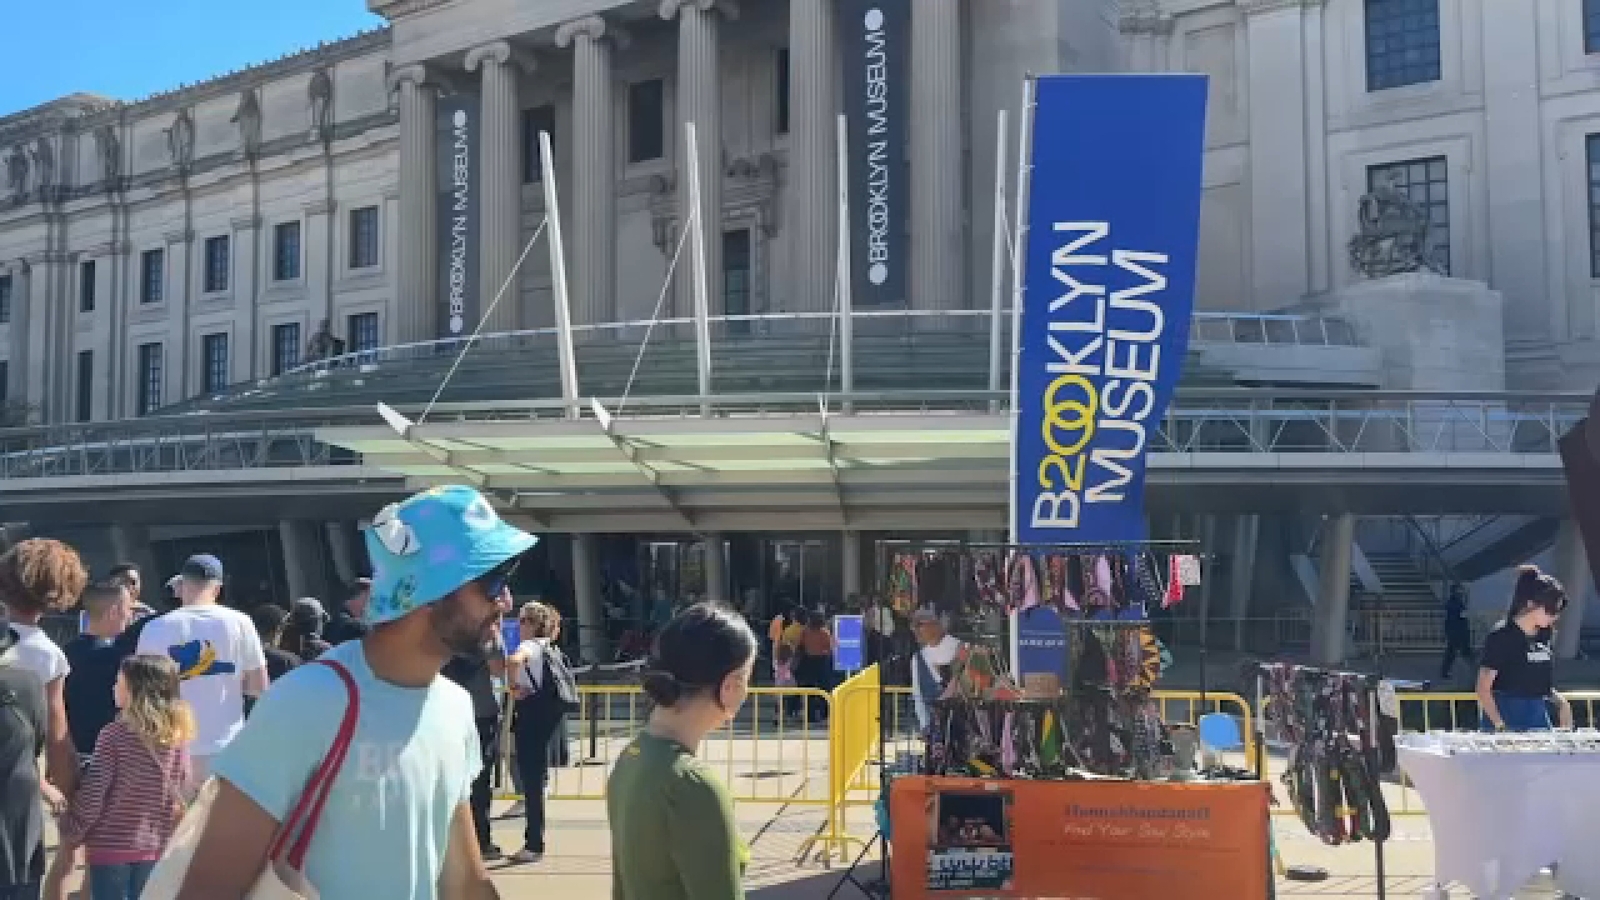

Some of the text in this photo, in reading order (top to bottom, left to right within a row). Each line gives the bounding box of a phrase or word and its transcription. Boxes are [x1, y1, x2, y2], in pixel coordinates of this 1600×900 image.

[449, 126, 468, 315] BROOKLYN MUSEUM
[865, 30, 888, 262] BROOKLYN MUSEUM
[1084, 249, 1169, 503] MUSEUM
